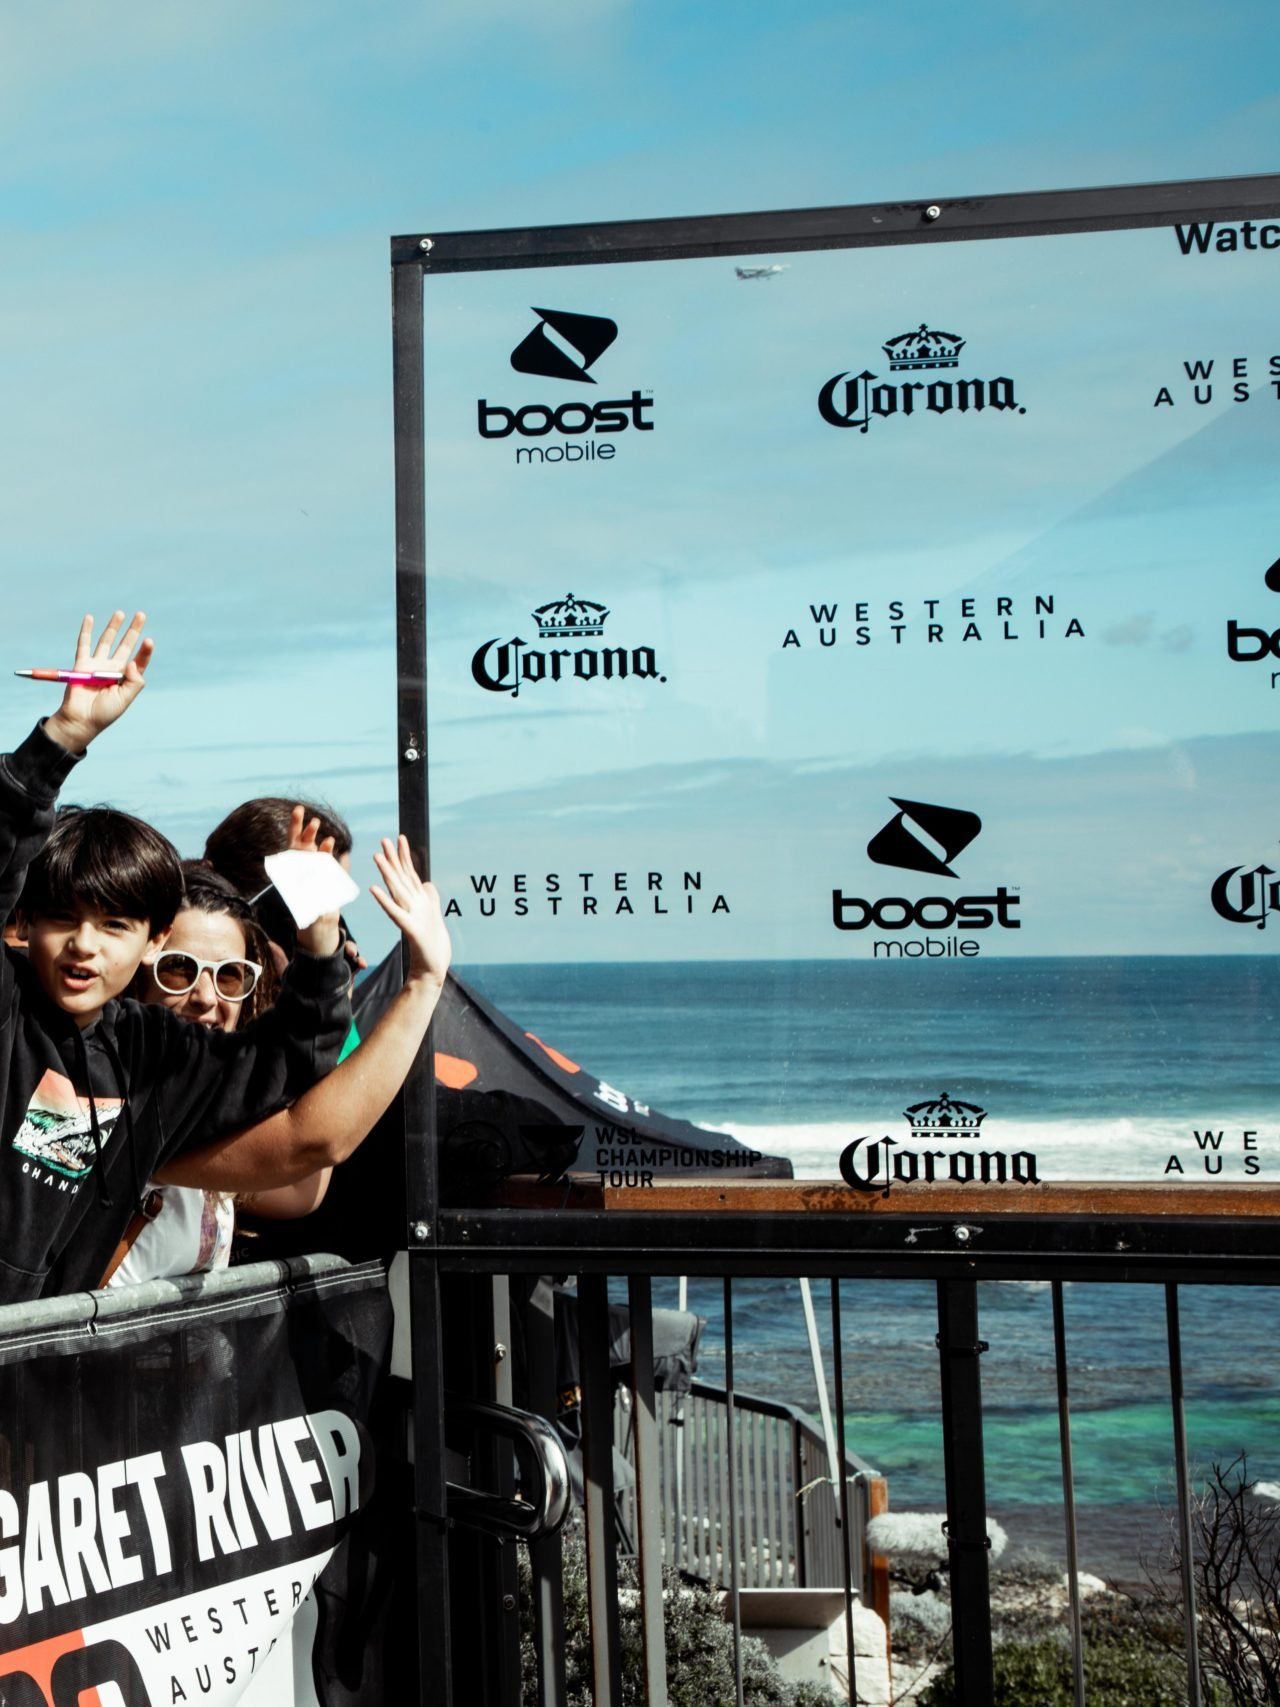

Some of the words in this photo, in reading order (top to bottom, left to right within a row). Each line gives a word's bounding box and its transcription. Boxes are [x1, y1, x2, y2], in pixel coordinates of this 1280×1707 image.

[477, 390, 654, 439] boost
[515, 440, 616, 464] mobile
[809, 595, 1054, 623] WESTERN
[782, 617, 1085, 648] AUSTRALIA
[470, 871, 701, 893] WESTERN
[445, 894, 730, 917] AUSTRALIA
[832, 887, 1021, 931] boost
[873, 936, 980, 958] mobile
[595, 1126, 642, 1146] WSL
[596, 1148, 763, 1169] CHAMPIONSHIP
[596, 1169, 654, 1189] TOUR
[180, 1410, 361, 1562] RIVER
[170, 1637, 277, 1705] AUST
